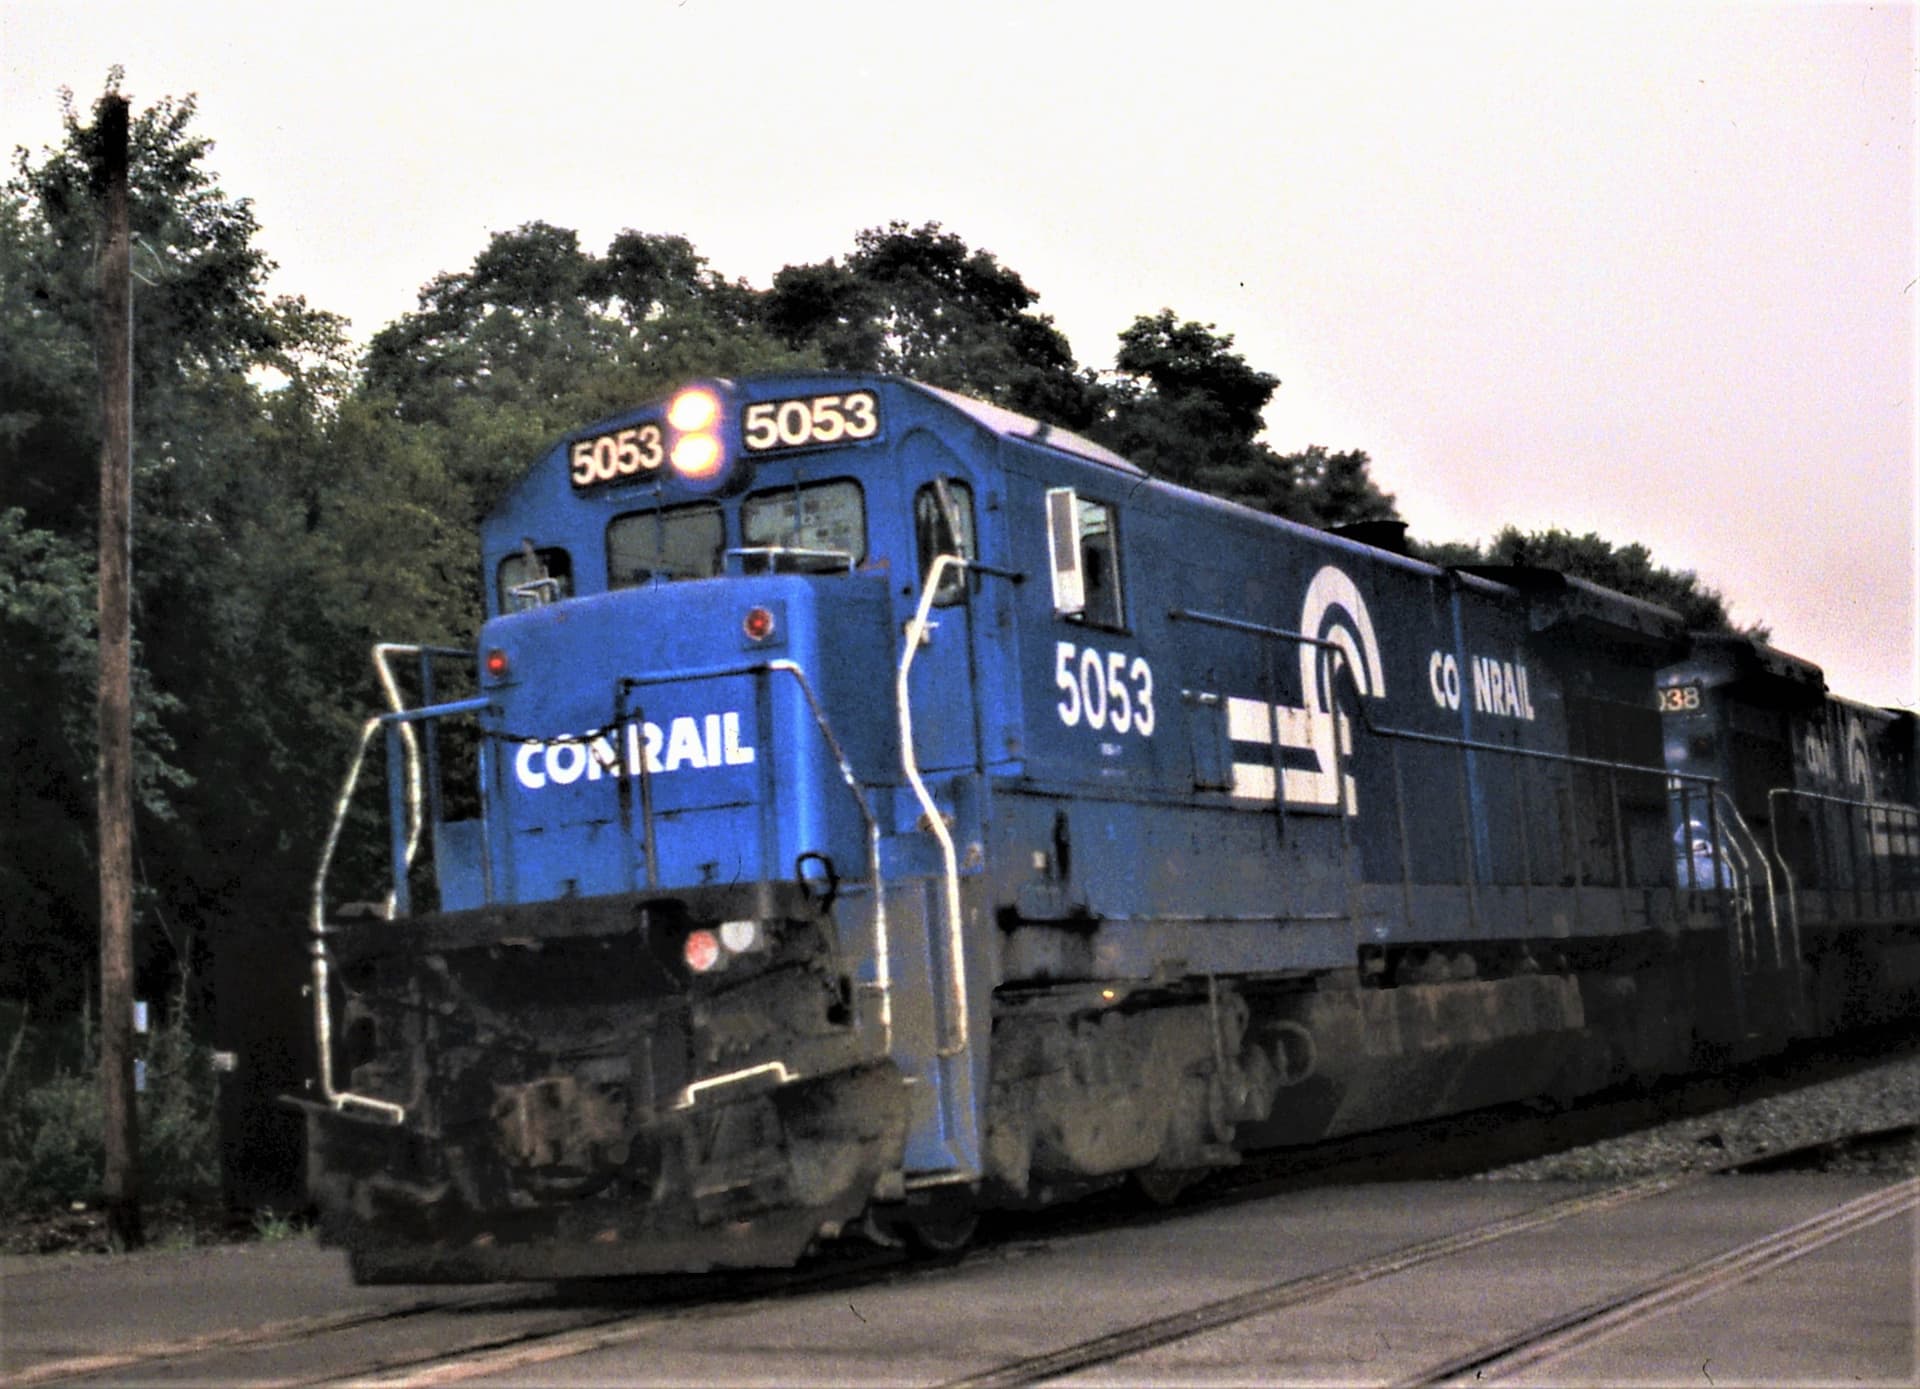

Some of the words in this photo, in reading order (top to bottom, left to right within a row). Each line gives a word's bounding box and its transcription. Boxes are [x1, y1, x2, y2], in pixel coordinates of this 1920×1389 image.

[572, 425, 663, 485] 5053
[744, 394, 877, 449] 5053
[1056, 641, 1155, 736] 5053
[515, 712, 755, 789] CONRAIL
